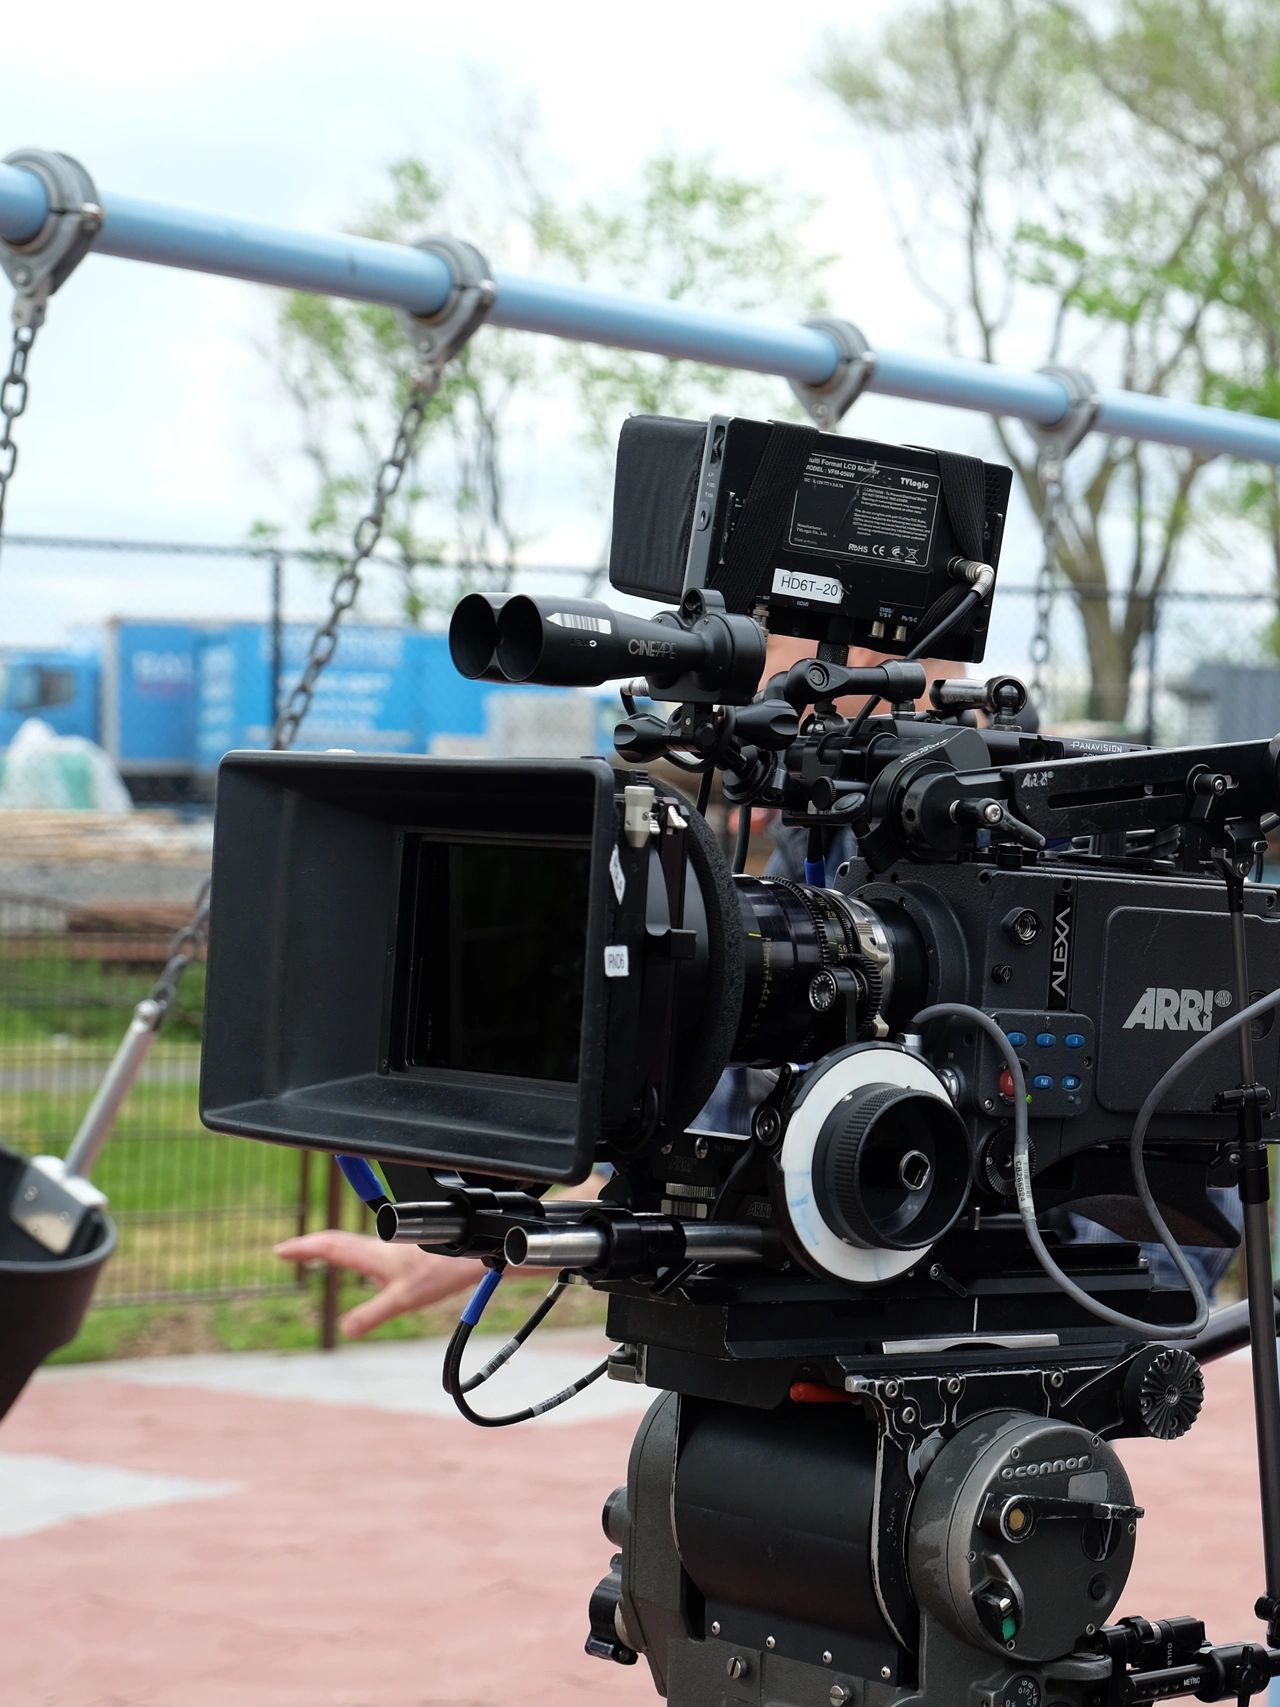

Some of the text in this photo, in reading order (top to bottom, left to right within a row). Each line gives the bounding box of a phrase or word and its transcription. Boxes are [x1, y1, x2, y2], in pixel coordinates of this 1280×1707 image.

[843, 462, 856, 471] LCD
[781, 576, 839, 596] HD6T-20
[1070, 740, 1123, 753] PANAVISION
[1051, 906, 1071, 998] ALEXA
[1121, 987, 1214, 1032] ARRI
[1001, 1455, 1089, 1480] oconnor
